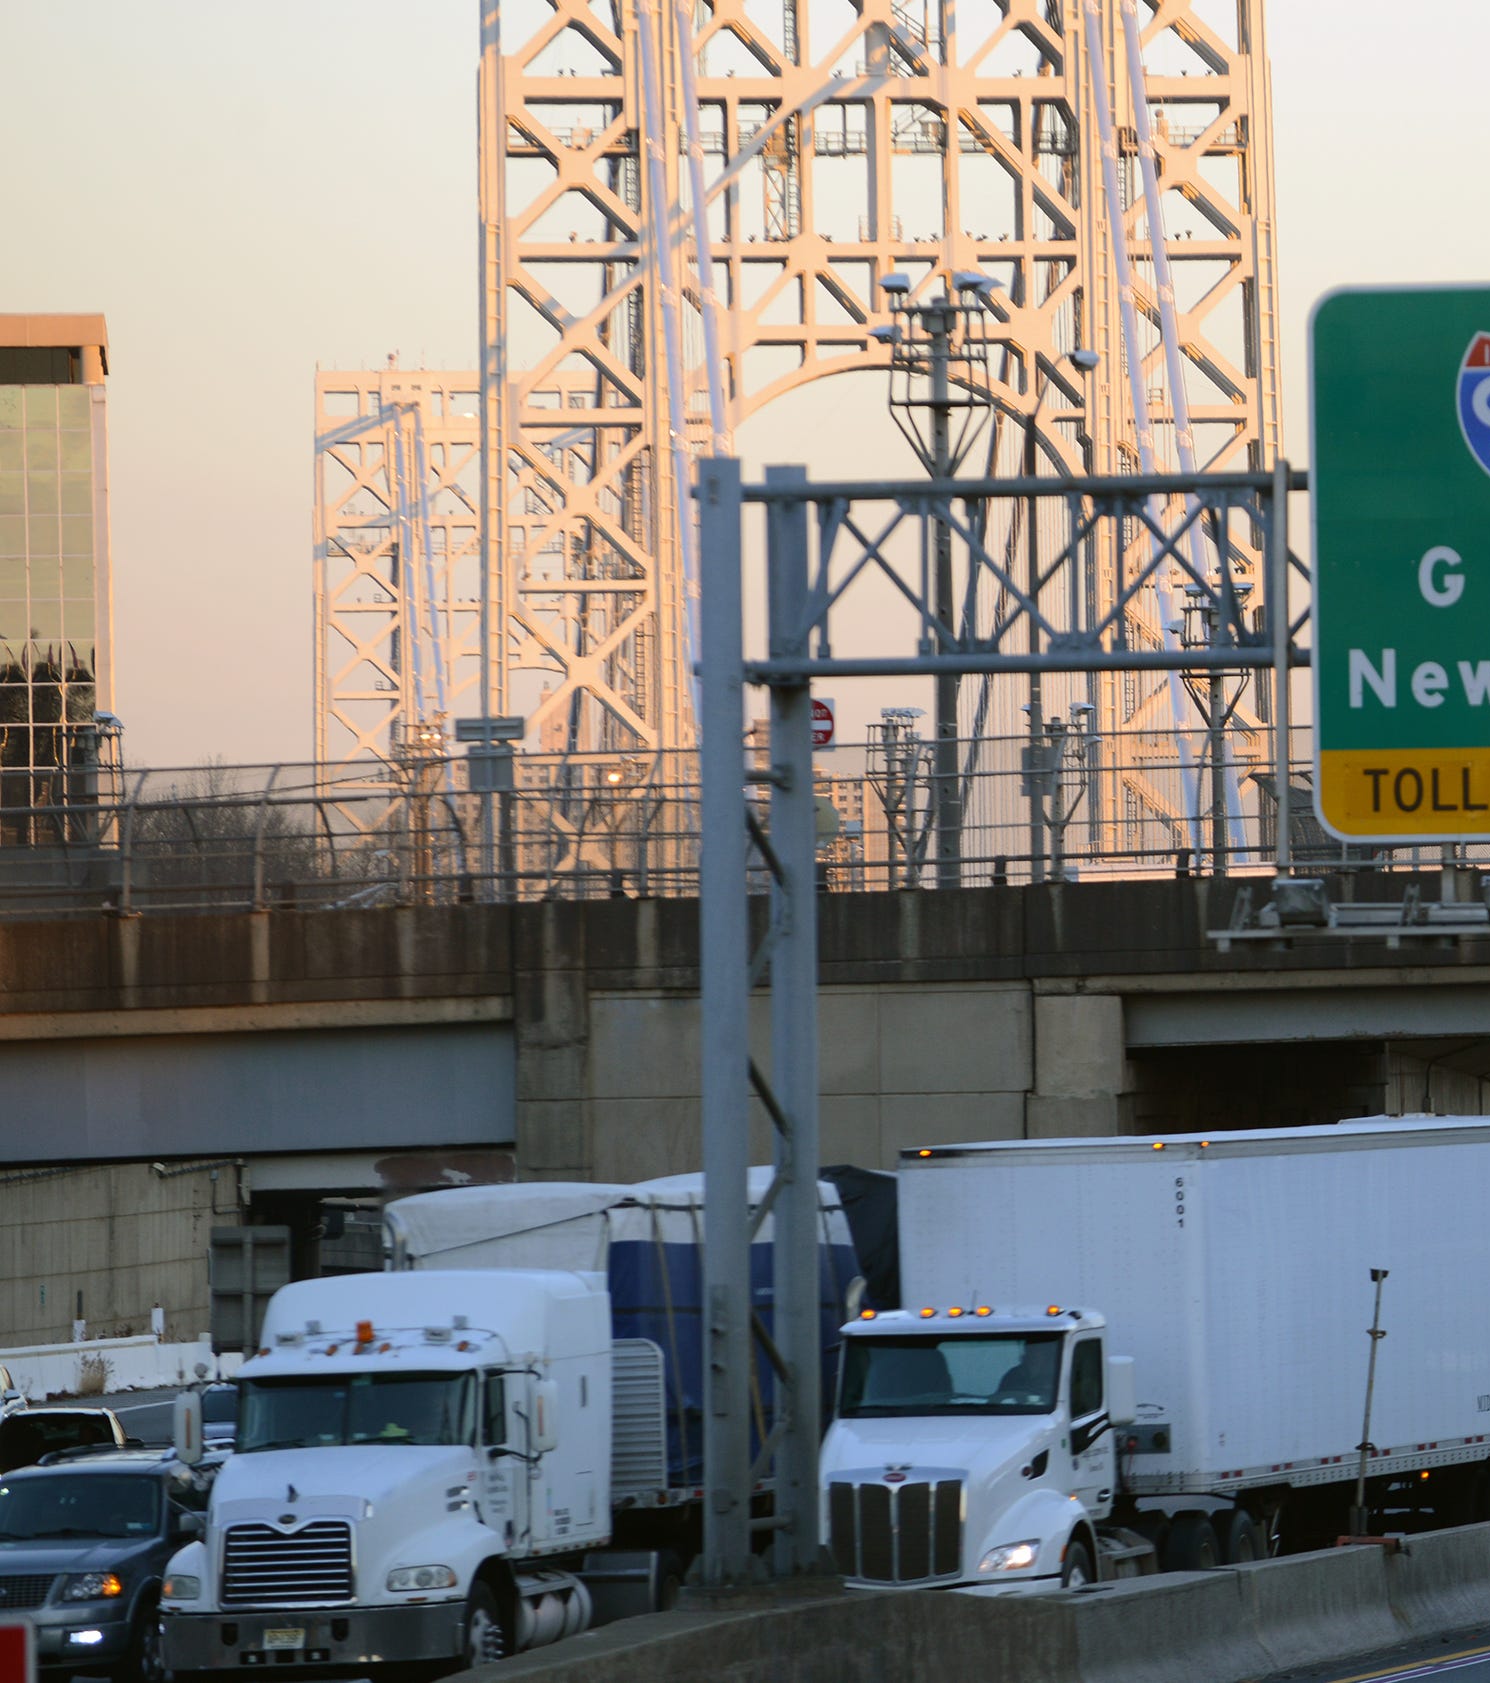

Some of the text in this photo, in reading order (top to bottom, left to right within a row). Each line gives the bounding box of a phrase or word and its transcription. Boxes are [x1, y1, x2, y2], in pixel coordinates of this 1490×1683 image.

[1418, 545, 1466, 607] G
[1362, 767, 1489, 812] TOLL
[1174, 1176, 1185, 1229] 6001
